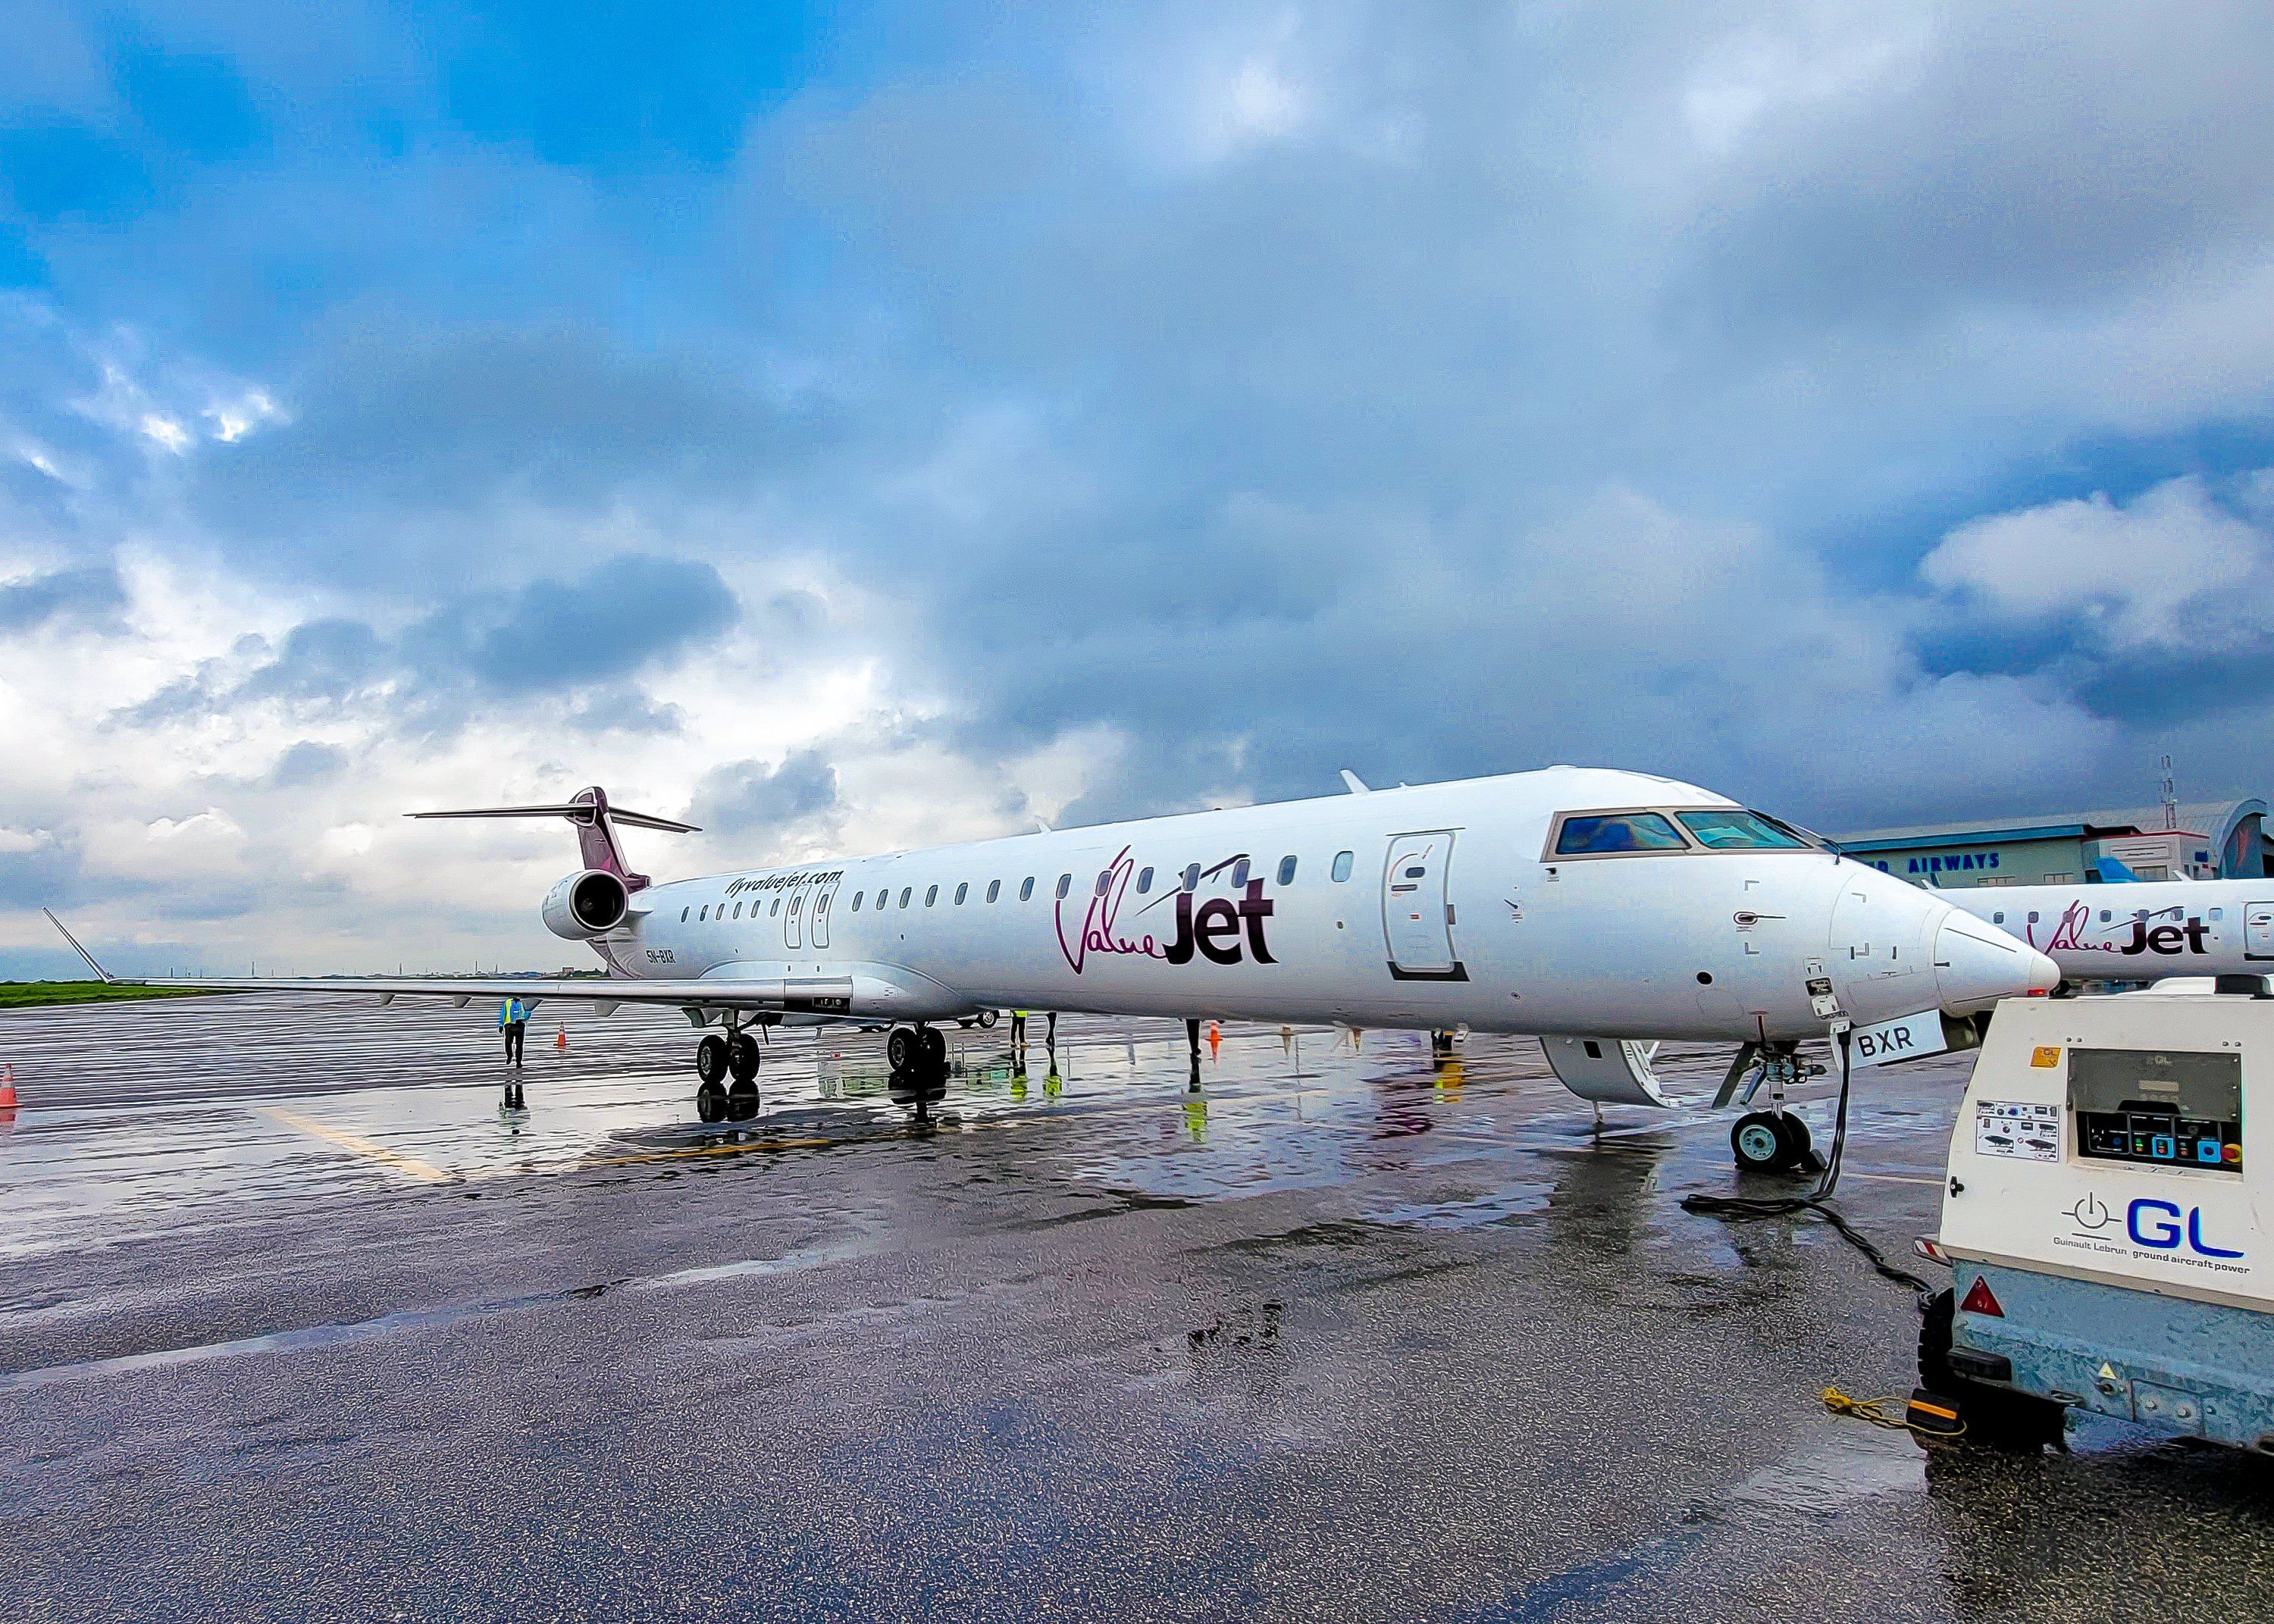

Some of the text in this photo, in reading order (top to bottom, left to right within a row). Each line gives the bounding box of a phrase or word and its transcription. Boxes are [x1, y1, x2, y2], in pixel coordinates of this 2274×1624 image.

[1907, 853, 2000, 874] AIRWAYS
[724, 870, 844, 899] flyvaluejet.com
[645, 949, 677, 964] 5N-BXR
[1857, 1026, 1915, 1058] BXR
[2126, 1197, 2246, 1259] GL
[2053, 1237, 2128, 1256] Guinault Lebrun
[2132, 1250, 2251, 1275] ground aircraft power
